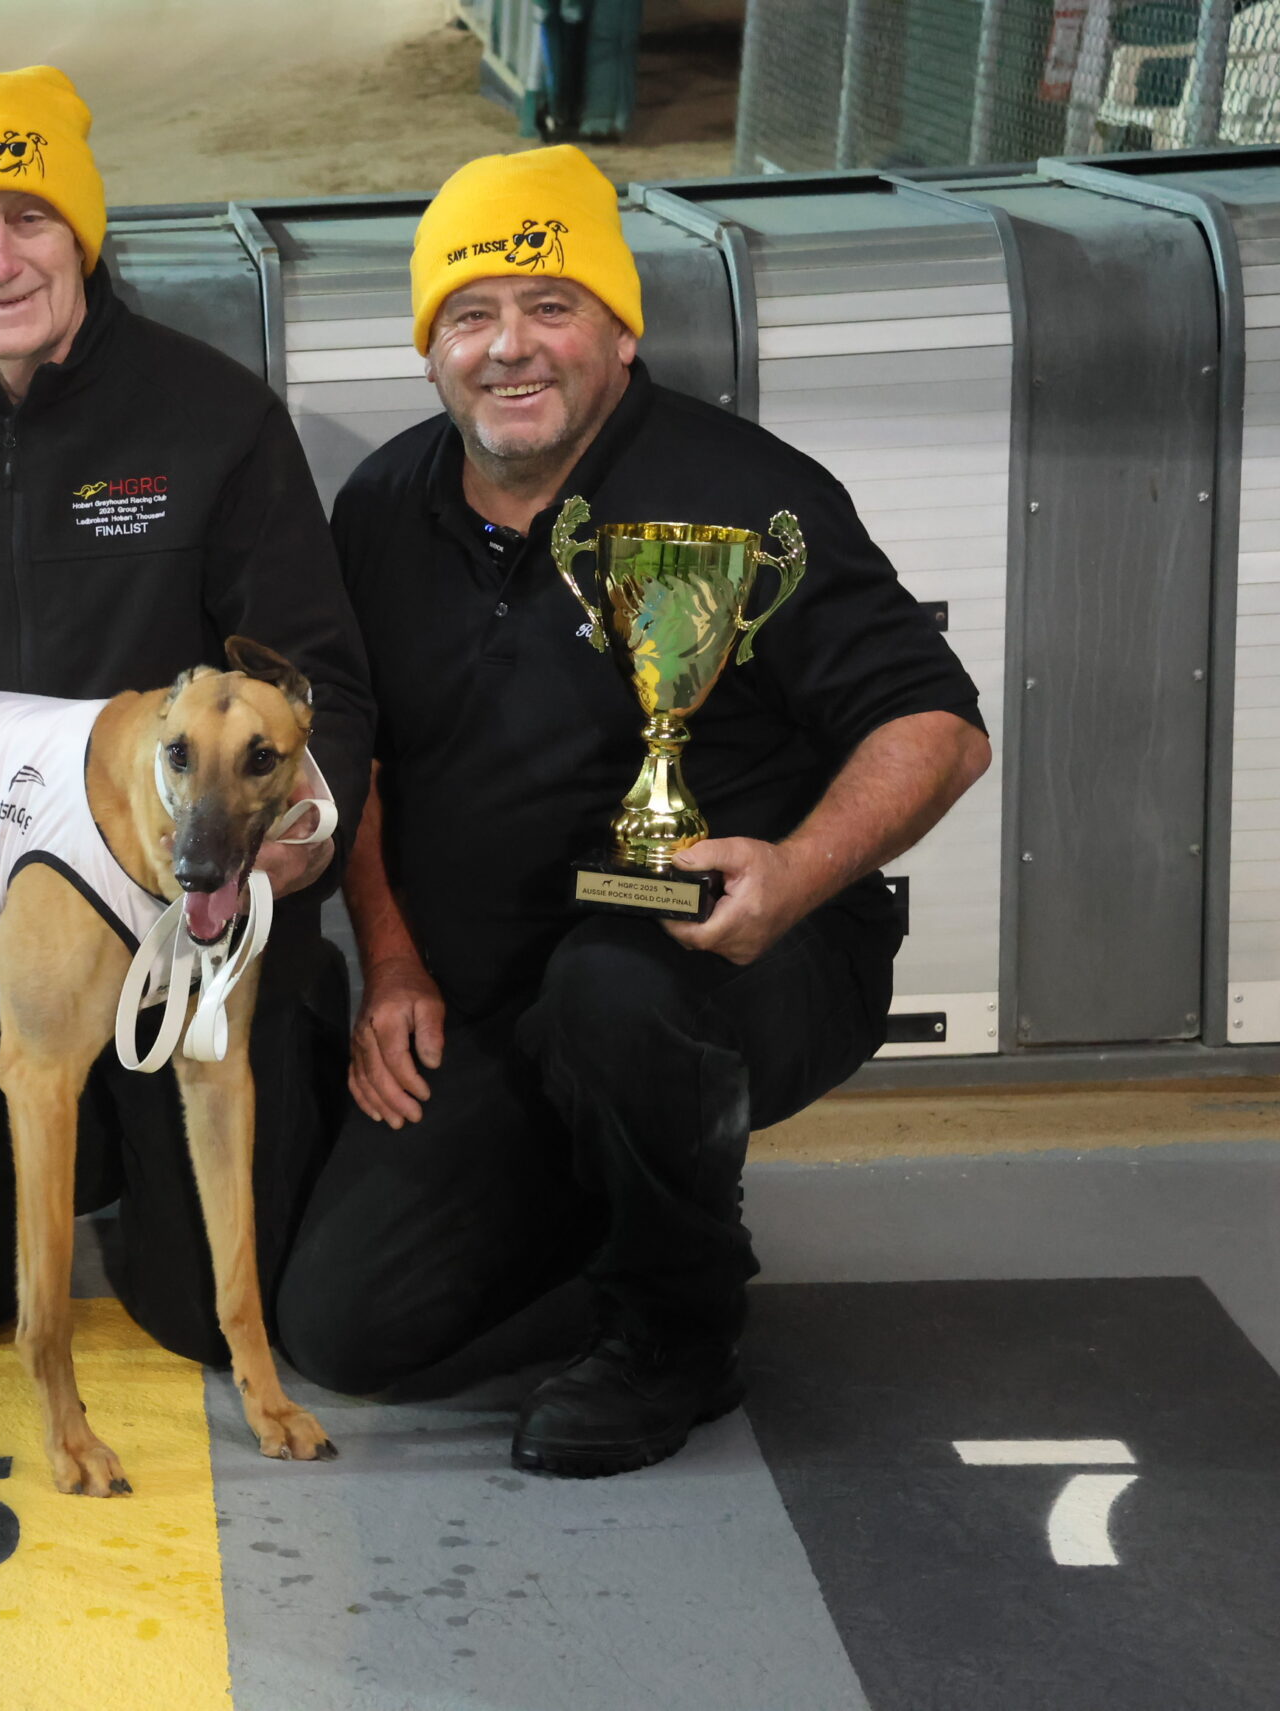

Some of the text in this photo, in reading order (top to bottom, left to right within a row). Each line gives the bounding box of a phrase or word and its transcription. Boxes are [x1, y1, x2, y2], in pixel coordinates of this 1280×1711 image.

[447, 239, 509, 266] SAVE TASSIE
[109, 476, 167, 496] HGRC
[72, 494, 167, 509] Hobart Greyhound Racing Club
[117, 506, 138, 514] Group
[76, 511, 166, 525] Ladbrokes Hobart Thousand
[95, 522, 149, 537] FINALIST
[618, 881, 659, 893] HGRC 2025
[582, 887, 693, 907] AUSSIE ROCKS GOLD CUP FINAL
[951, 1439, 1139, 1567] 7
